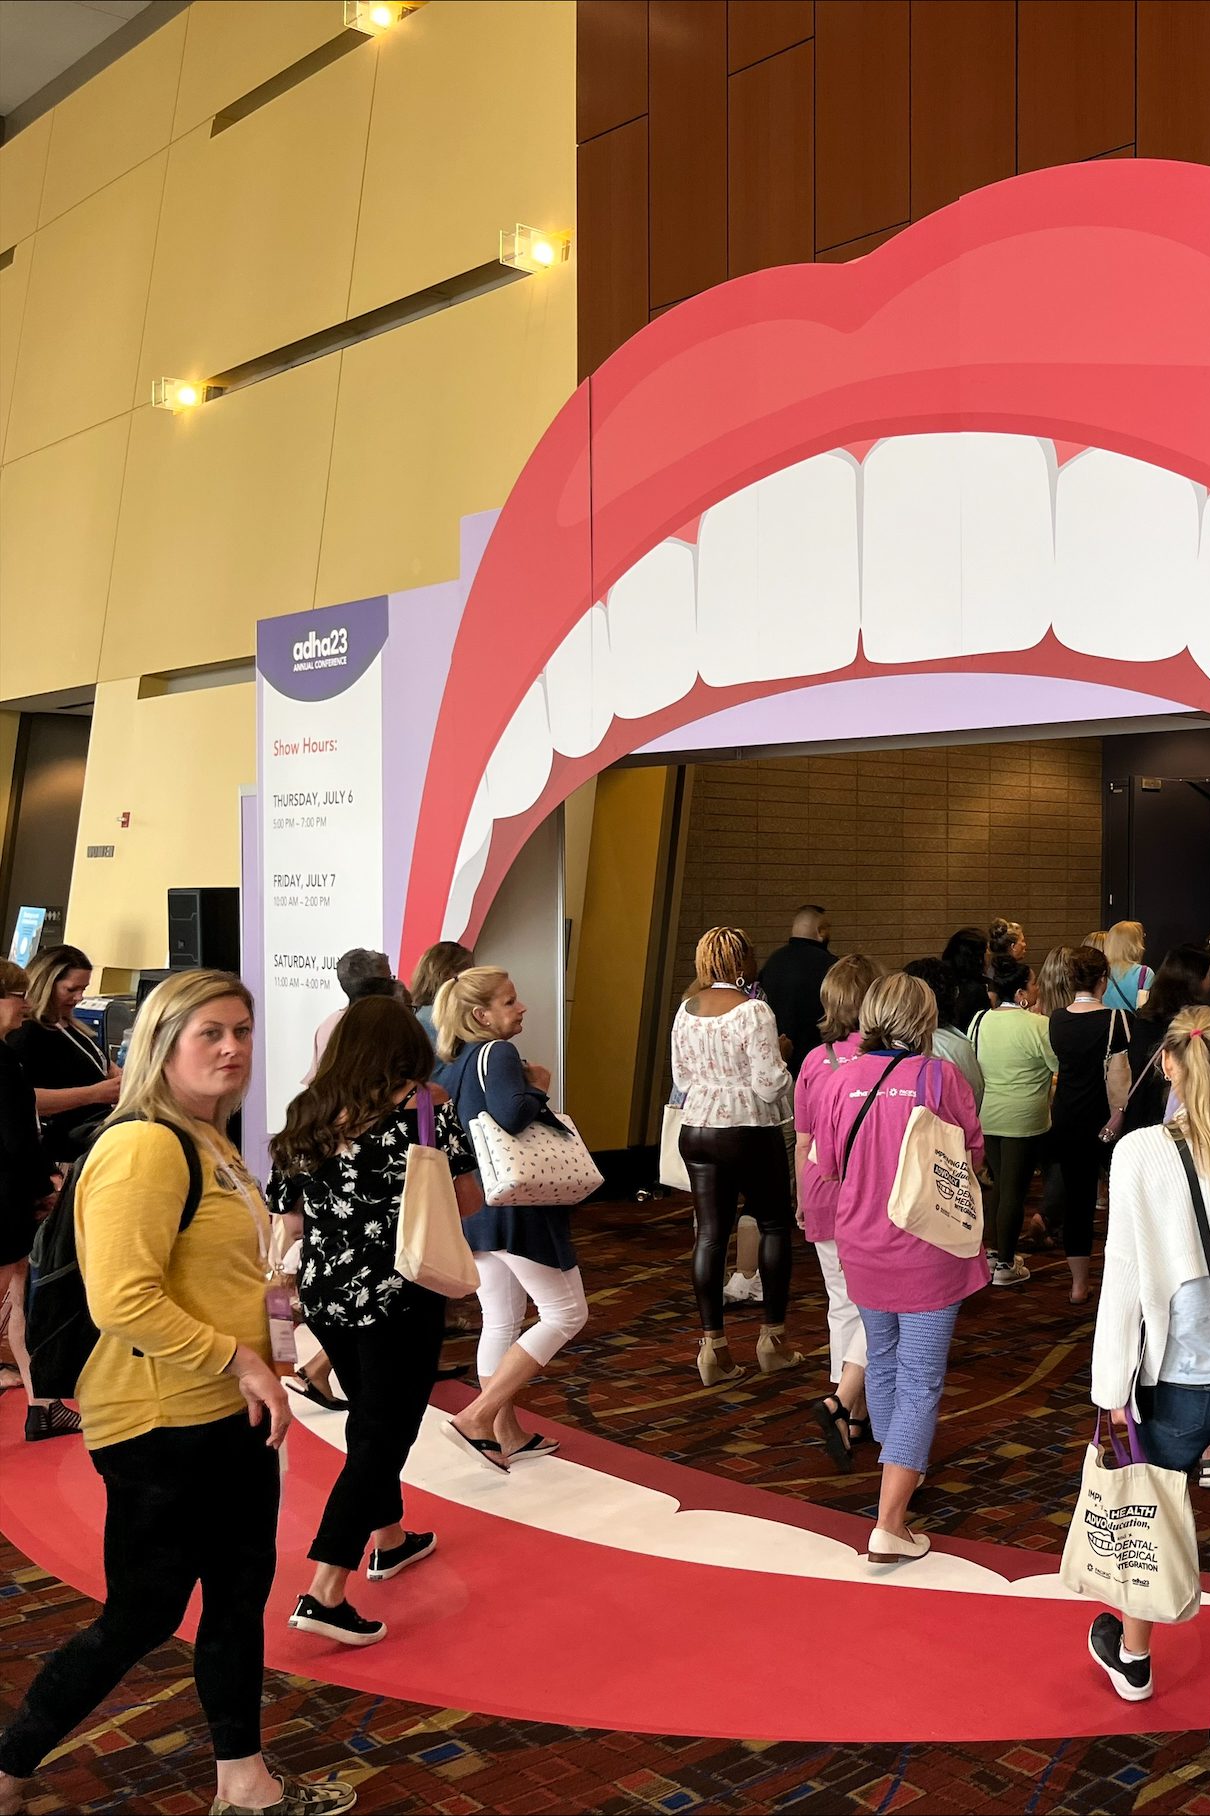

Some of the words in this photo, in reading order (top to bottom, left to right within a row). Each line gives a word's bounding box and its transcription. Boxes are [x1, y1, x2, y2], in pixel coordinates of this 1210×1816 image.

[293, 627, 348, 661] adha23
[293, 661, 315, 672] ANNUAL
[314, 656, 348, 669] CONFERENCE
[273, 740, 299, 757] Show
[302, 738, 338, 755] Hours:
[273, 792, 320, 808] THURSDAY,
[323, 790, 346, 805] JULY
[347, 789, 354, 804] 6
[285, 817, 295, 829] PM
[316, 816, 327, 827] PM
[273, 874, 303, 890] FRIDAY,
[306, 874, 328, 888] JULY
[330, 873, 336, 887] 7
[288, 896, 299, 907] AM
[319, 896, 330, 907] PM
[274, 954, 319, 971] SATURDAY,
[289, 977, 299, 988] AM
[319, 979, 331, 990] PM
[1111, 1506, 1155, 1519] HEALTH
[1115, 1540, 1158, 1551] DENTAL-
